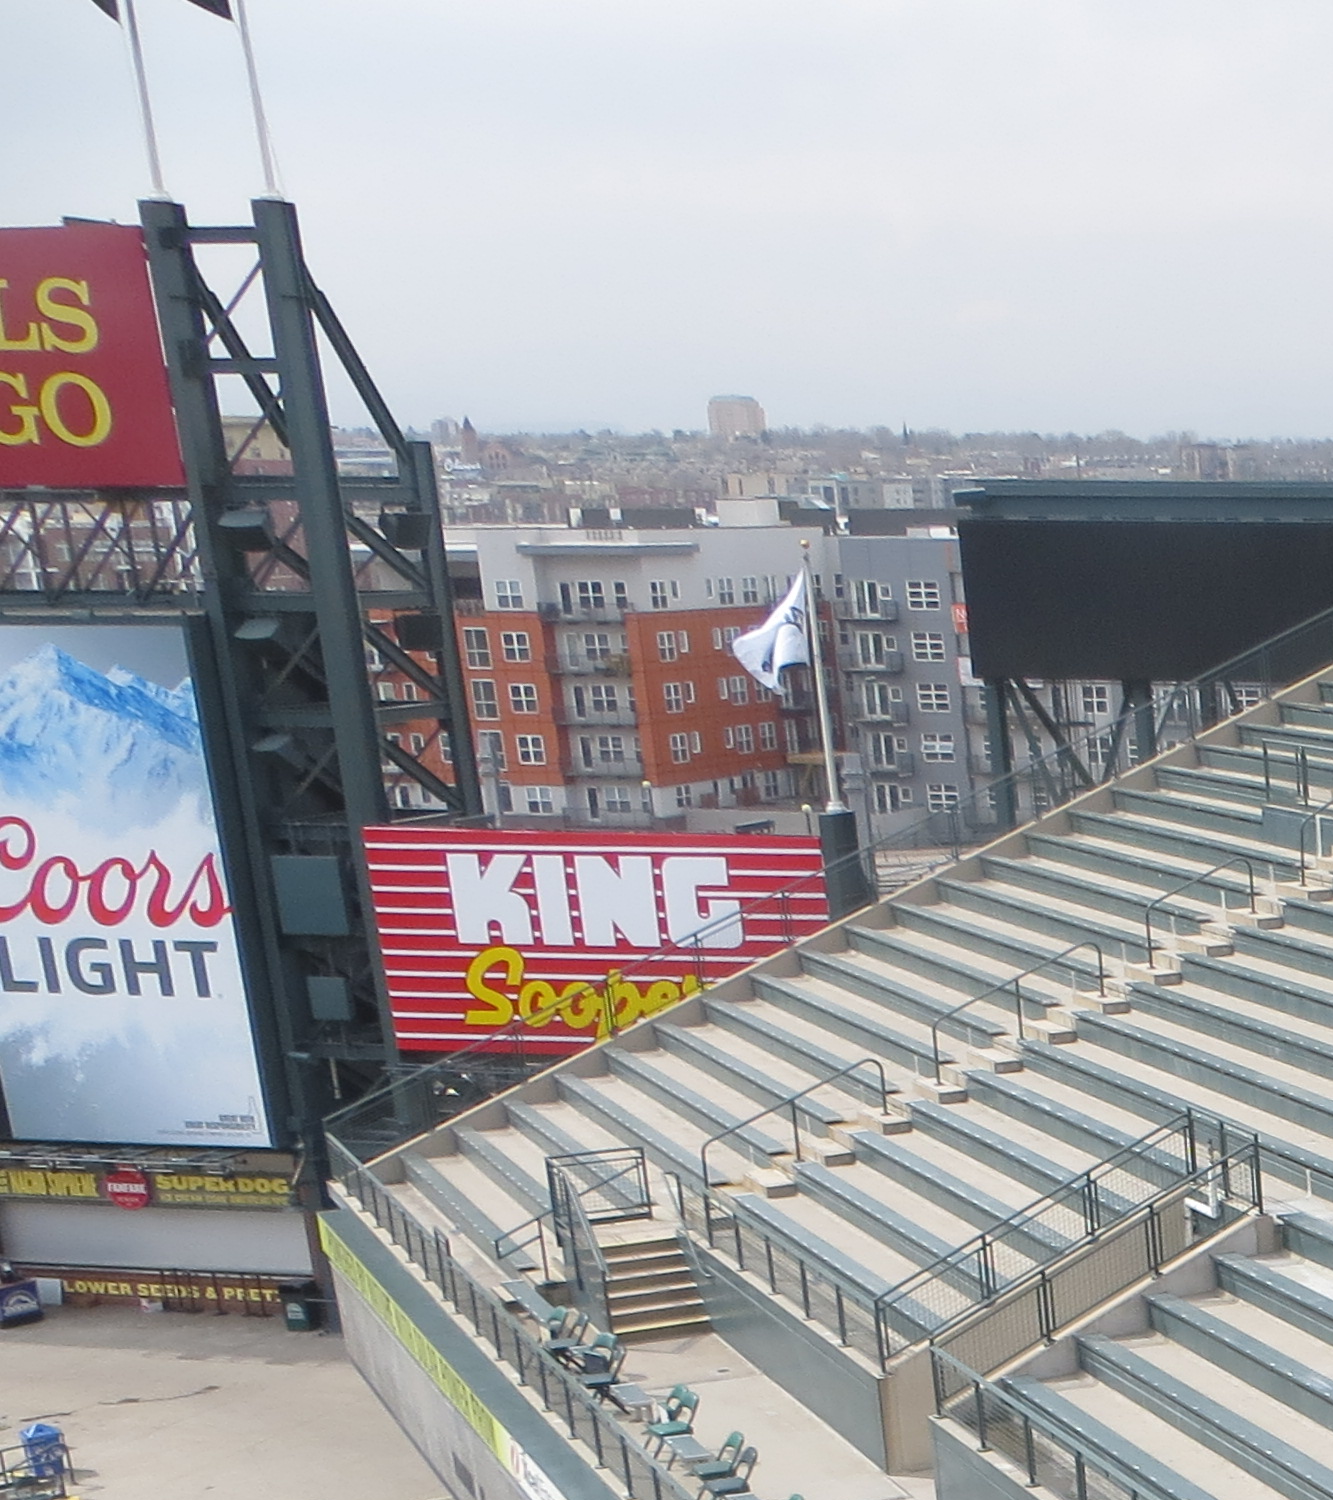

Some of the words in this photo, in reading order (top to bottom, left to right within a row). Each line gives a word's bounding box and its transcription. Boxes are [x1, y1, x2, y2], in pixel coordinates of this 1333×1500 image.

[445, 852, 743, 949] KING
[0, 936, 218, 998] LIGHT
[237, 1177, 290, 1194] DOG
[204, 1286, 218, 1300] &
